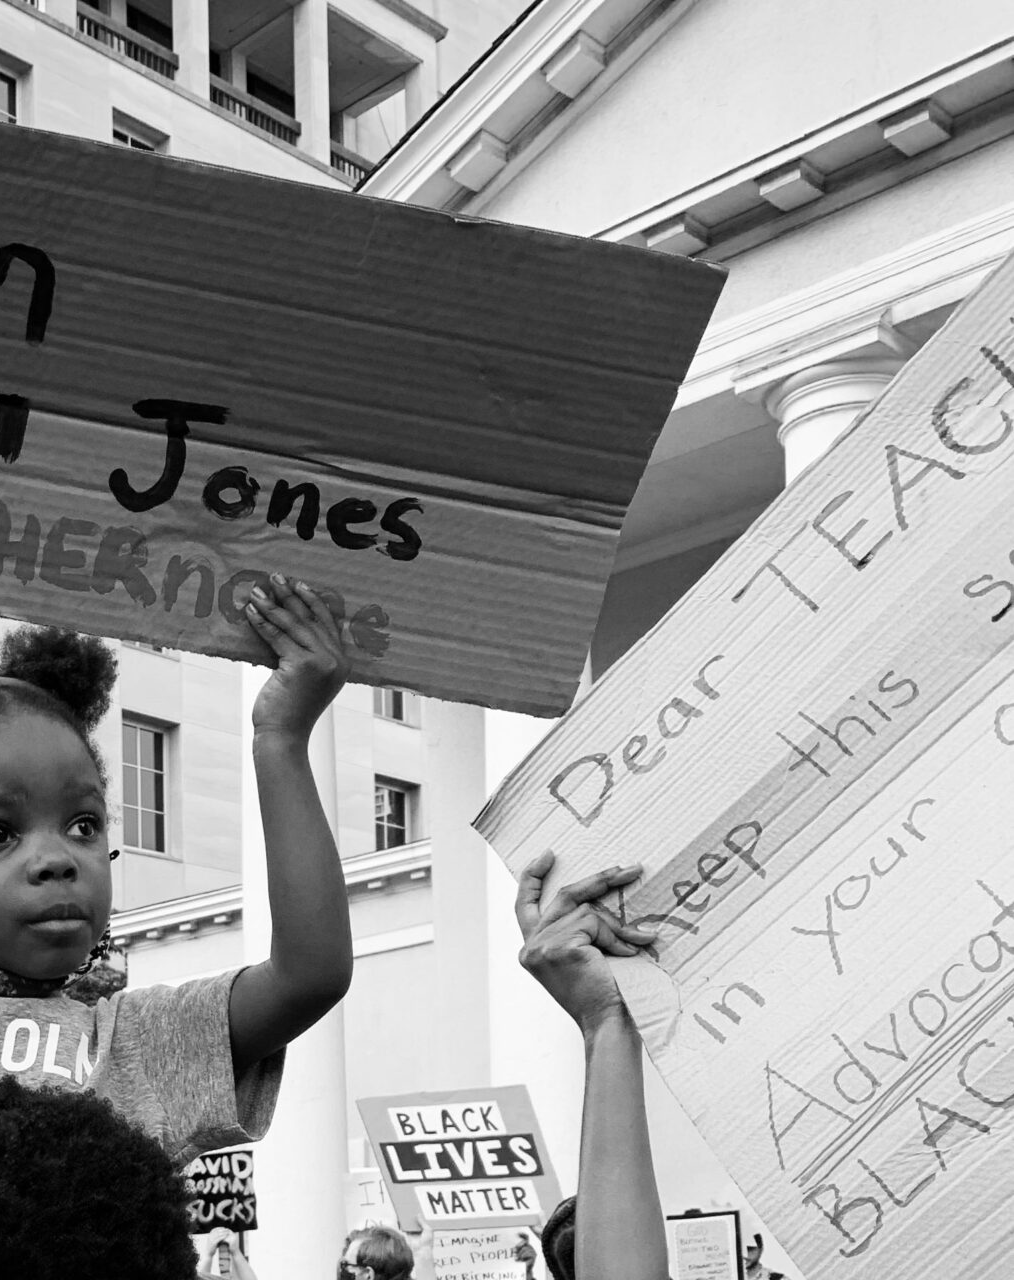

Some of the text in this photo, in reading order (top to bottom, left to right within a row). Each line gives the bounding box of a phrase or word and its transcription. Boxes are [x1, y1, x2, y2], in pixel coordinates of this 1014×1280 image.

[109, 399, 425, 560] Jones
[547, 655, 725, 827] Dear
[776, 670, 920, 777] this
[766, 879, 1014, 1170] Advocat
[182, 1153, 253, 1179] AVID
[386, 1137, 537, 1180] LIVES
[396, 1106, 498, 1136] BLACK
[802, 1015, 1014, 1258] BLAC
[427, 1187, 530, 1215] MATTER
